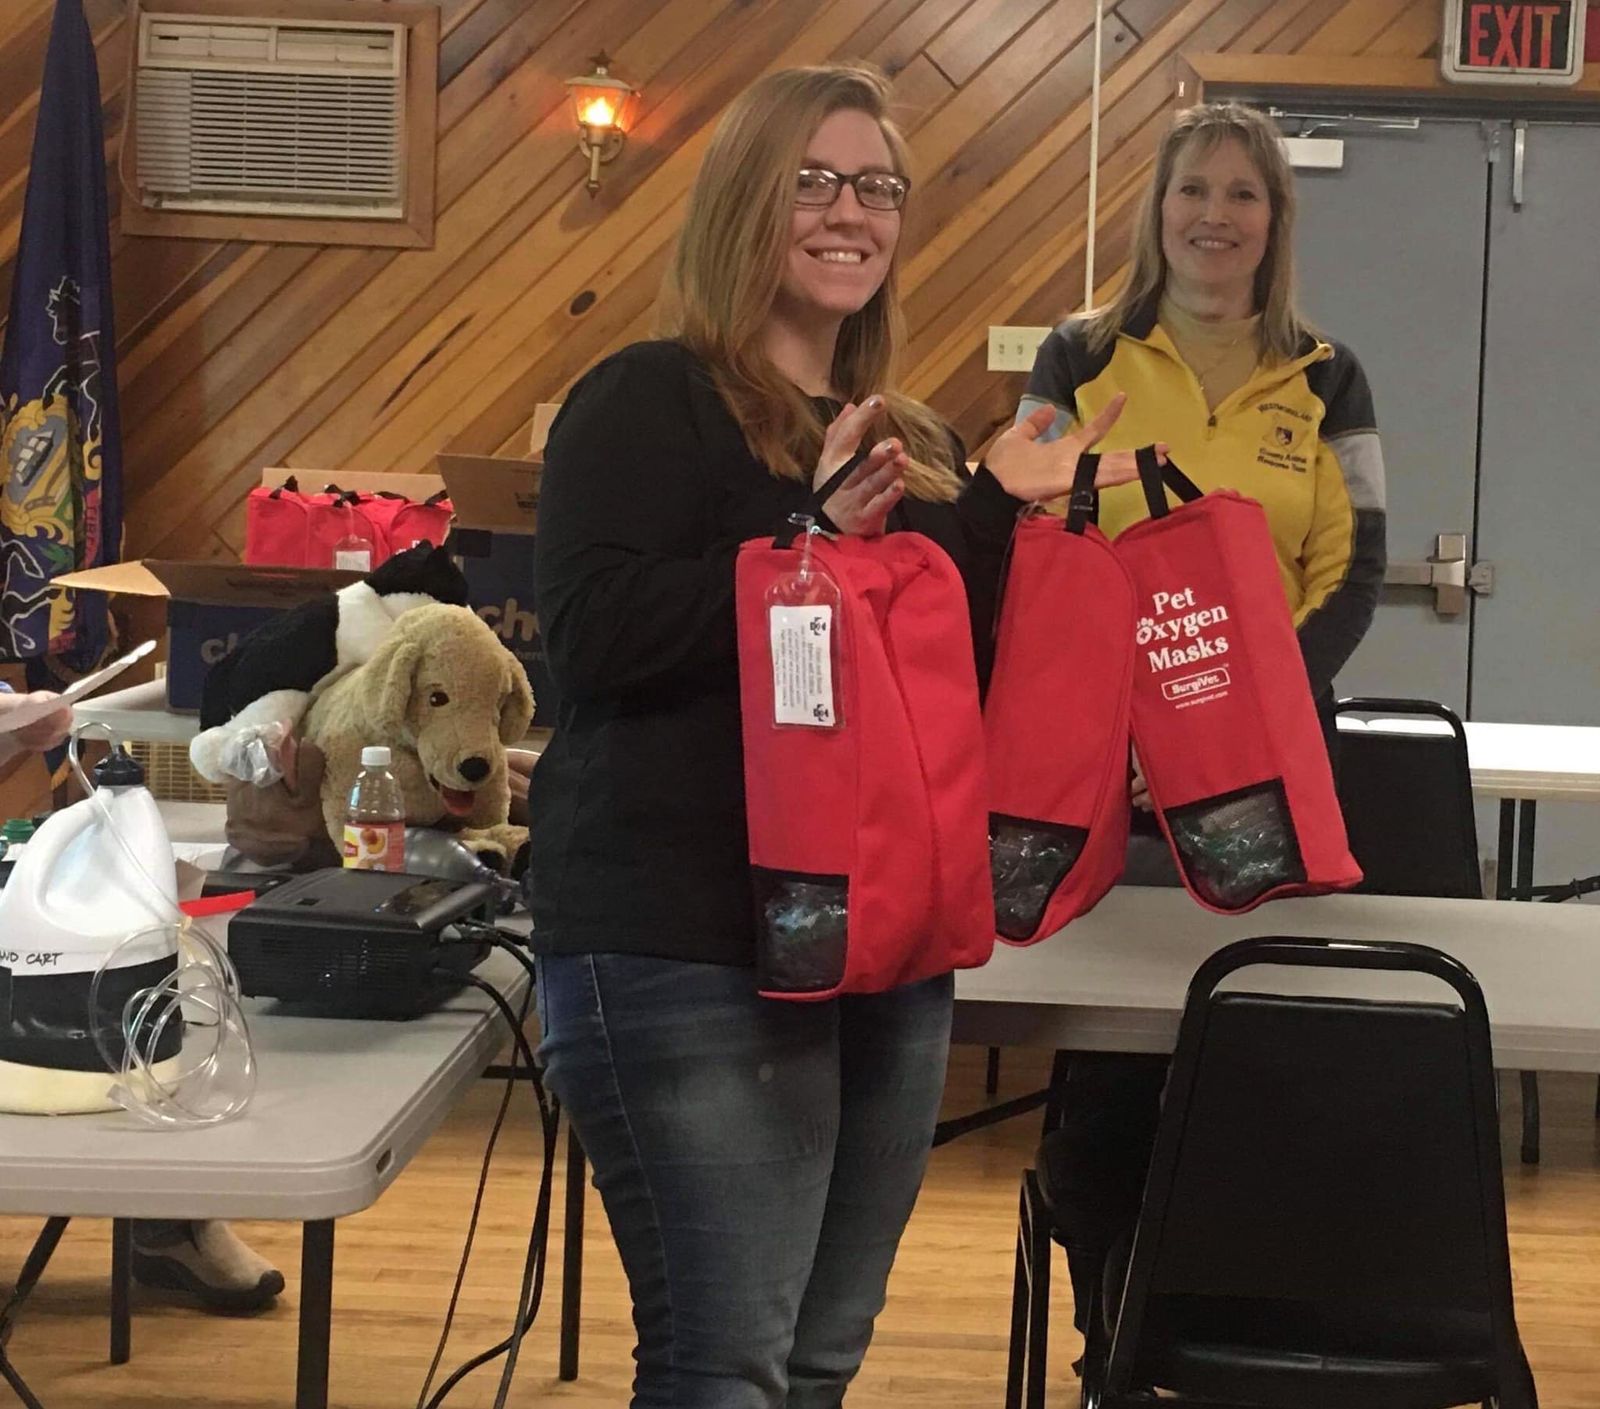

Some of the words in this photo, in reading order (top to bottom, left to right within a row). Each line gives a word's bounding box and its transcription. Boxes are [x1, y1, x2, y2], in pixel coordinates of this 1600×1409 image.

[1469, 4, 1561, 69] EXIT
[1152, 587, 1196, 616] Pet
[1136, 605, 1229, 645] Oxygen
[1147, 636, 1229, 673] Masks
[25, 951, 63, 967] CART
